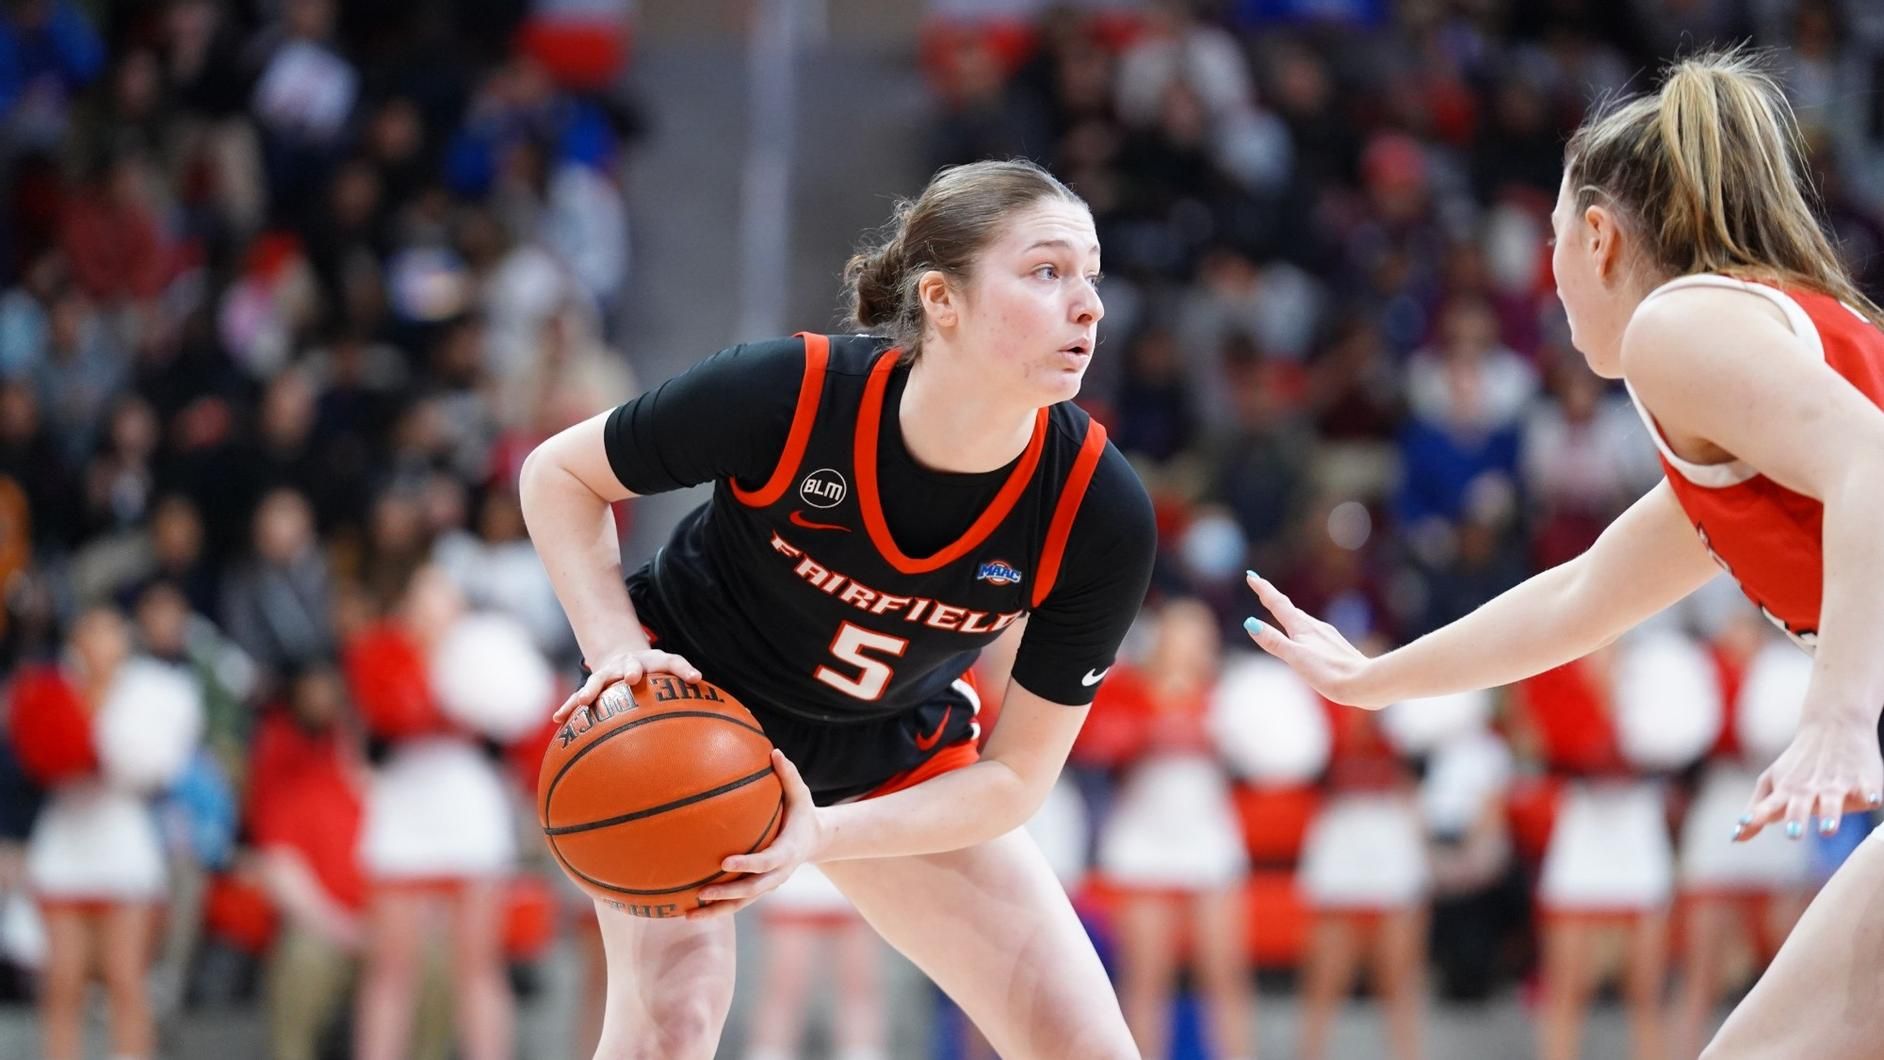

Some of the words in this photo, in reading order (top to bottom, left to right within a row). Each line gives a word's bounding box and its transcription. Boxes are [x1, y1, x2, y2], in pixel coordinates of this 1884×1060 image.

[803, 478, 843, 501] BLM
[976, 562, 1022, 583] MAAC
[812, 619, 910, 701] 5
[651, 677, 726, 703] THE
